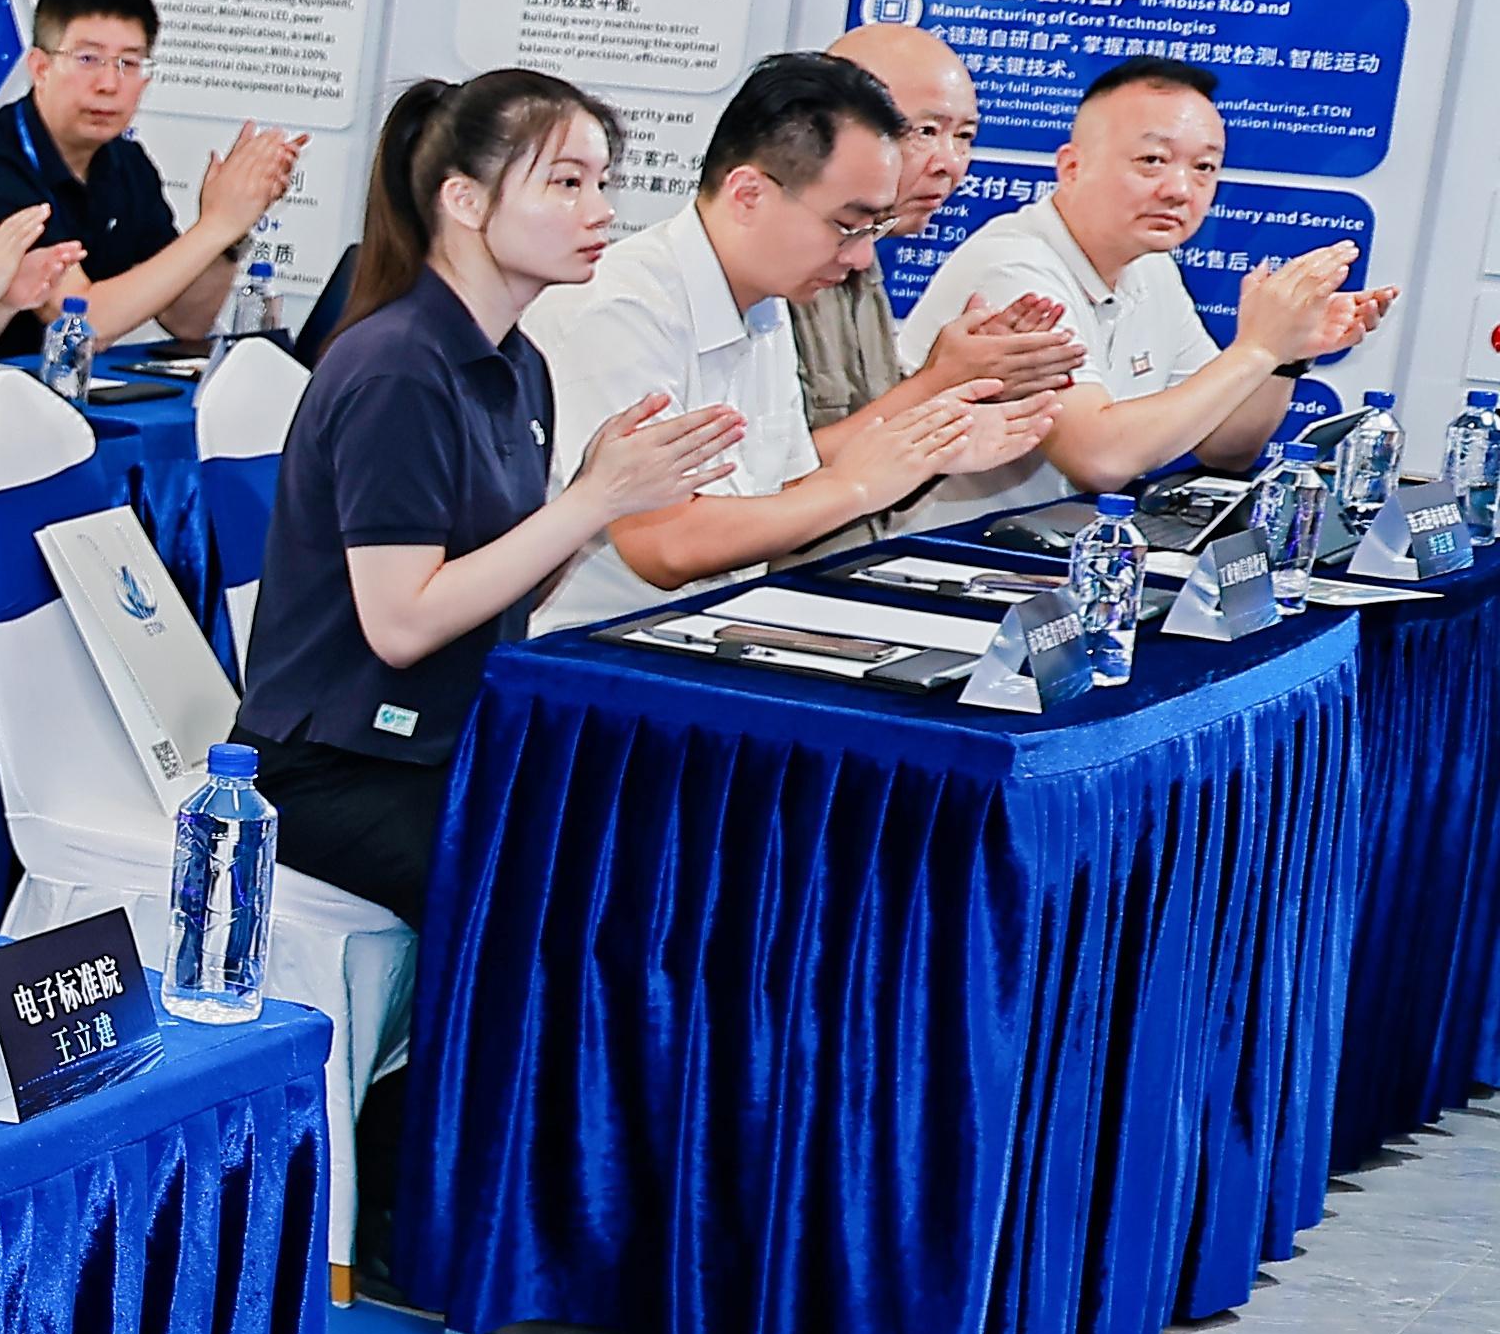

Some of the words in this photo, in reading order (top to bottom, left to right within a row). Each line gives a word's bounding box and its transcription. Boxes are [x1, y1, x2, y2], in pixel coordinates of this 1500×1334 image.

[930, 3, 1046, 26] Manufacturing
[1049, 10, 1066, 25] of
[1068, 12, 1104, 27] Core
[1108, 14, 1216, 36] Technologies
[1258, 1, 1290, 16] and
[1266, 210, 1297, 226] and
[1300, 212, 1364, 232] Service
[13, 955, 123, 1025] 电子标准院
[51, 1012, 117, 1066] 王立建
